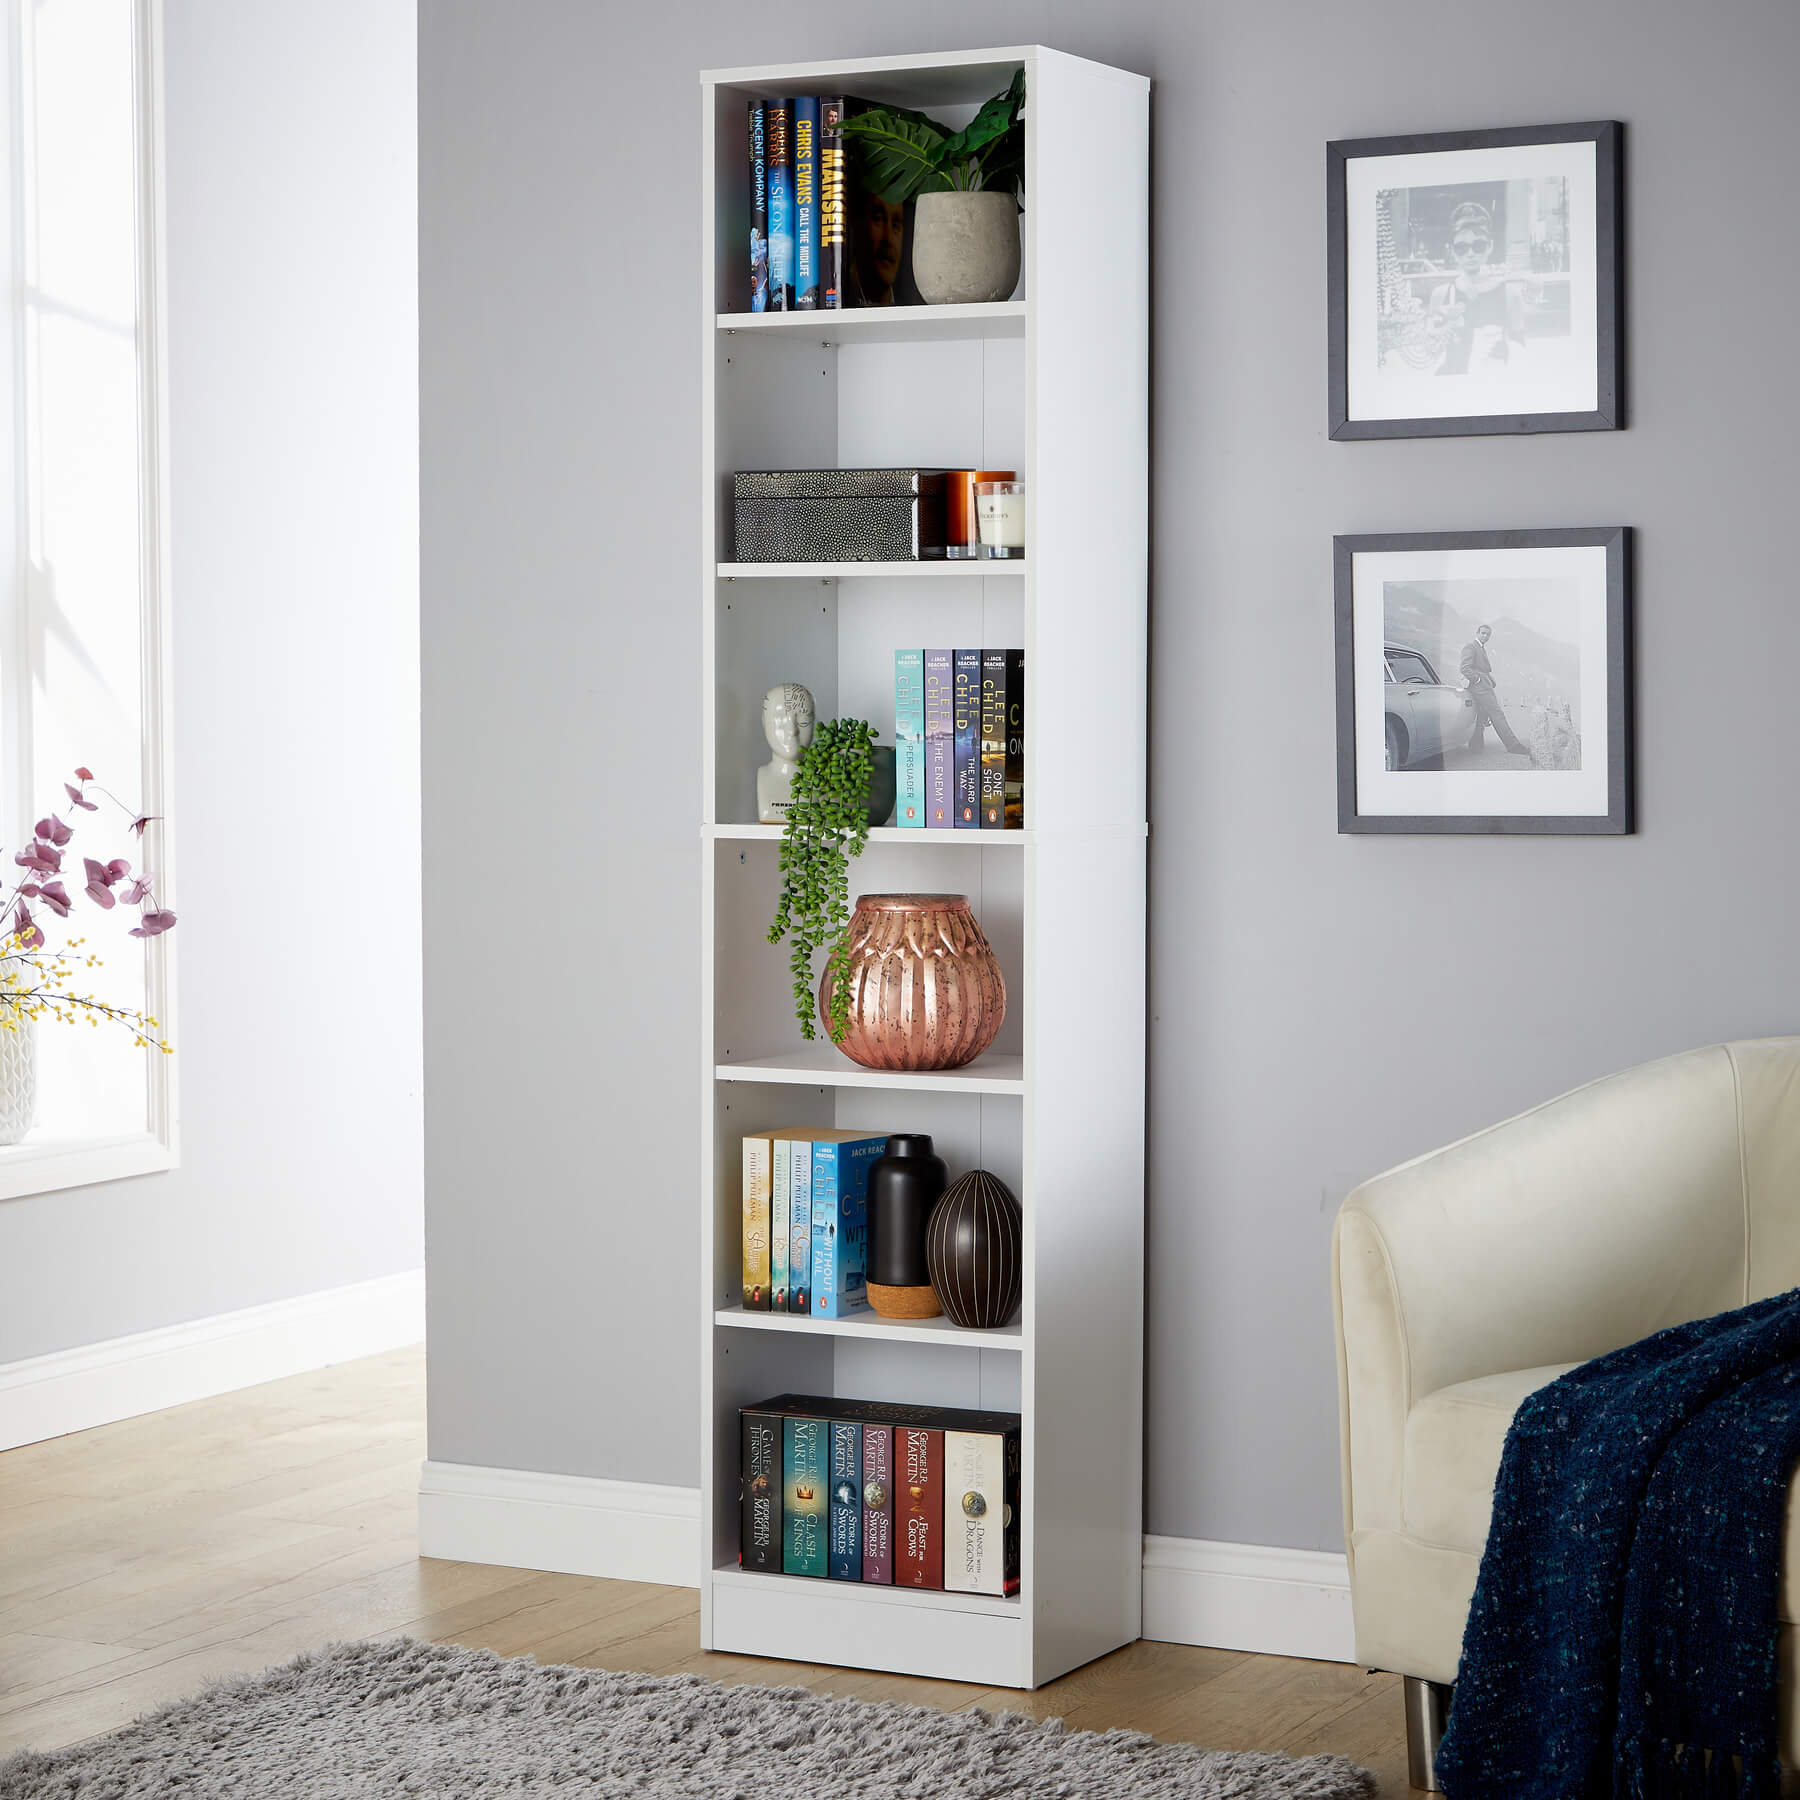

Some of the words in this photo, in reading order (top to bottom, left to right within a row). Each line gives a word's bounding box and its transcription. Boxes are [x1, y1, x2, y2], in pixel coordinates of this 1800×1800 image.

[754, 108, 764, 155] VINCENT
[767, 109, 778, 167] HARRIS
[796, 120, 812, 159] CHRIS
[754, 159, 765, 212] KOMPANY
[796, 163, 812, 205] EVANS
[821, 148, 845, 248] MANSELL
[799, 207, 810, 227] CALL
[799, 228, 810, 244] THE
[799, 246, 810, 277] MIDLIFE
[898, 673, 909, 729] CHILD
[927, 676, 939, 731] CHILD
[941, 686, 950, 719] LEE
[956, 673, 968, 730] CHILD
[969, 684, 980, 719] LEE
[983, 679, 994, 733] CHILD
[995, 690, 1005, 723] LEE
[934, 740, 944, 763] THE
[967, 757, 976, 775] THE
[905, 745, 914, 799] PERSUADER
[934, 766, 944, 804] ENEMY
[959, 770, 968, 790] WAY
[967, 777, 975, 803] HARD
[983, 769, 993, 800] SHOT
[993, 772, 1002, 797] ONE
[851, 1147, 866, 1157] JACK
[867, 1145, 886, 1154] REAC
[814, 1165, 825, 1221] CHILD
[825, 1176, 835, 1209] LEE
[814, 1250, 824, 1275] FAIL
[824, 1236, 833, 1292] WITHOUT
[749, 1426, 761, 1476] THRONES
[762, 1429, 774, 1464] GAME
[794, 1421, 809, 1483] MARTIN
[808, 1423, 817, 1465] GEORGE
[835, 1424, 847, 1478] MARTIN
[847, 1426, 856, 1460] GEORGE
[865, 1429, 878, 1482] MARTIN
[877, 1430, 887, 1465] GEORGE
[907, 1430, 920, 1484] MARTIN
[919, 1432, 929, 1467] GEORGE
[753, 1497, 765, 1547] MARTIN
[807, 1501, 816, 1509] A
[793, 1518, 805, 1557] KINGS
[806, 1513, 818, 1558] CLASH
[838, 1507, 849, 1555] SWORDS
[848, 1515, 857, 1547] STORM
[869, 1510, 880, 1558] SWORDS
[879, 1518, 889, 1550] STORM
[908, 1518, 919, 1558] CROWS
[918, 1522, 929, 1550] FEAST
[966, 1519, 977, 1573] DRAGONS
[976, 1528, 985, 1558] DANCE
[848, 1548, 854, 1556] OF
[879, 1550, 885, 1558] OF
